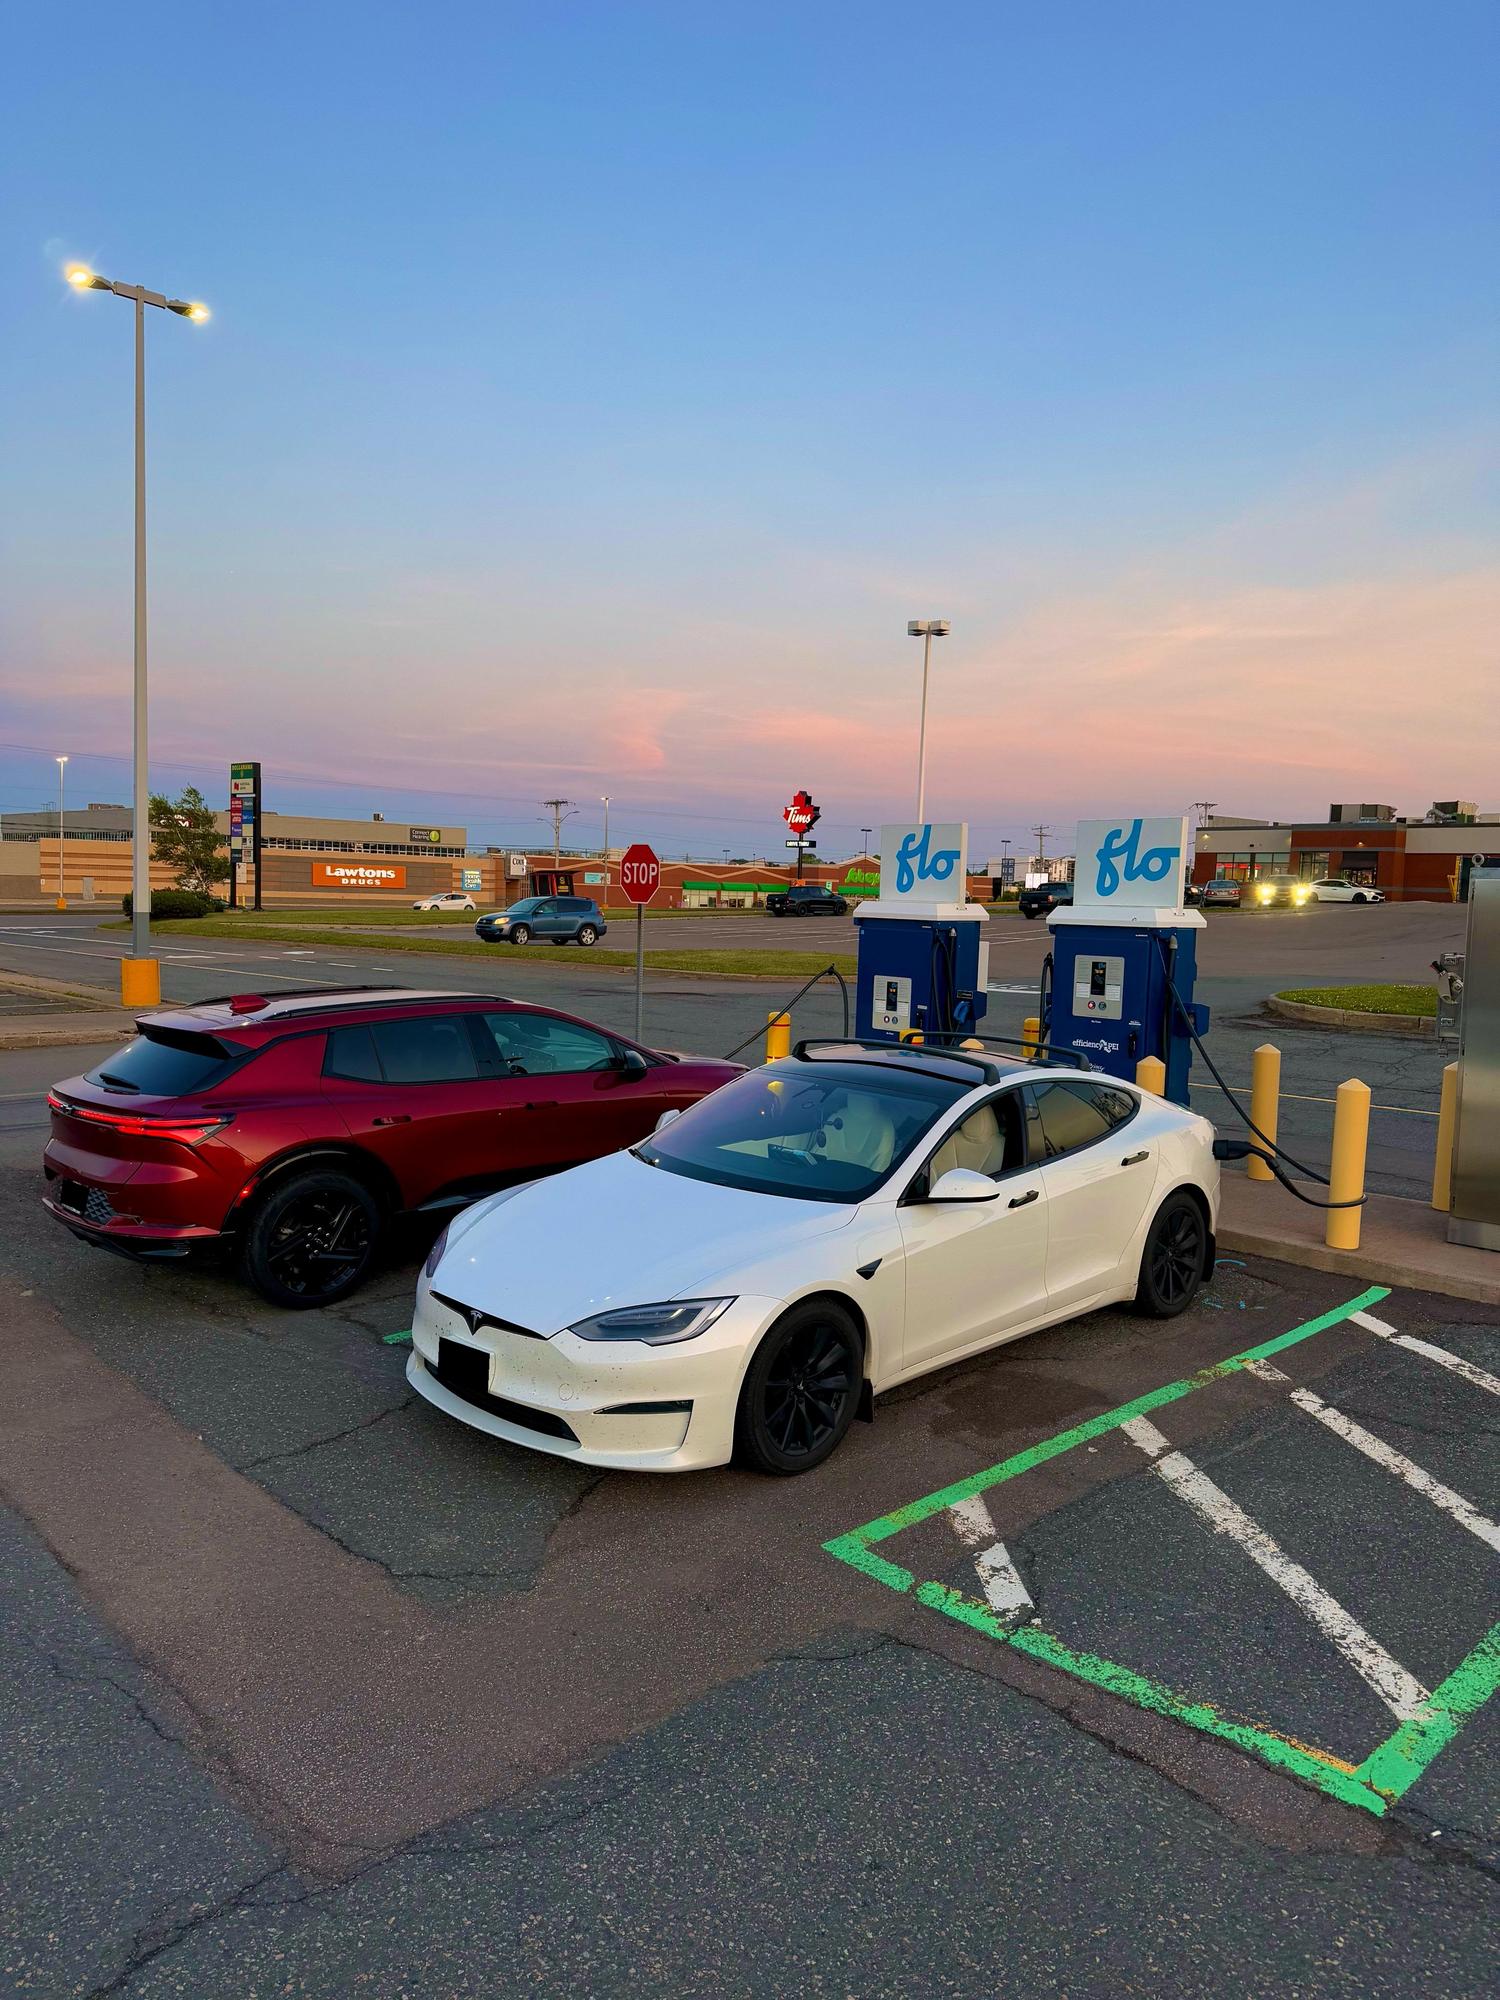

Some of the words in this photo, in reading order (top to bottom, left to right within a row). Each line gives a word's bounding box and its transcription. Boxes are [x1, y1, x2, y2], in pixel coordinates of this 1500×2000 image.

[786, 806, 811, 824] Tims
[896, 825, 960, 893] flo
[1096, 819, 1180, 896] flo
[325, 865, 396, 879] Lawtons
[623, 862, 658, 885] STOP
[845, 868, 880, 885] Sobey
[341, 878, 381, 886] DRUGS
[1072, 1039, 1103, 1050] efficiency
[1107, 1042, 1119, 1051] PEI
